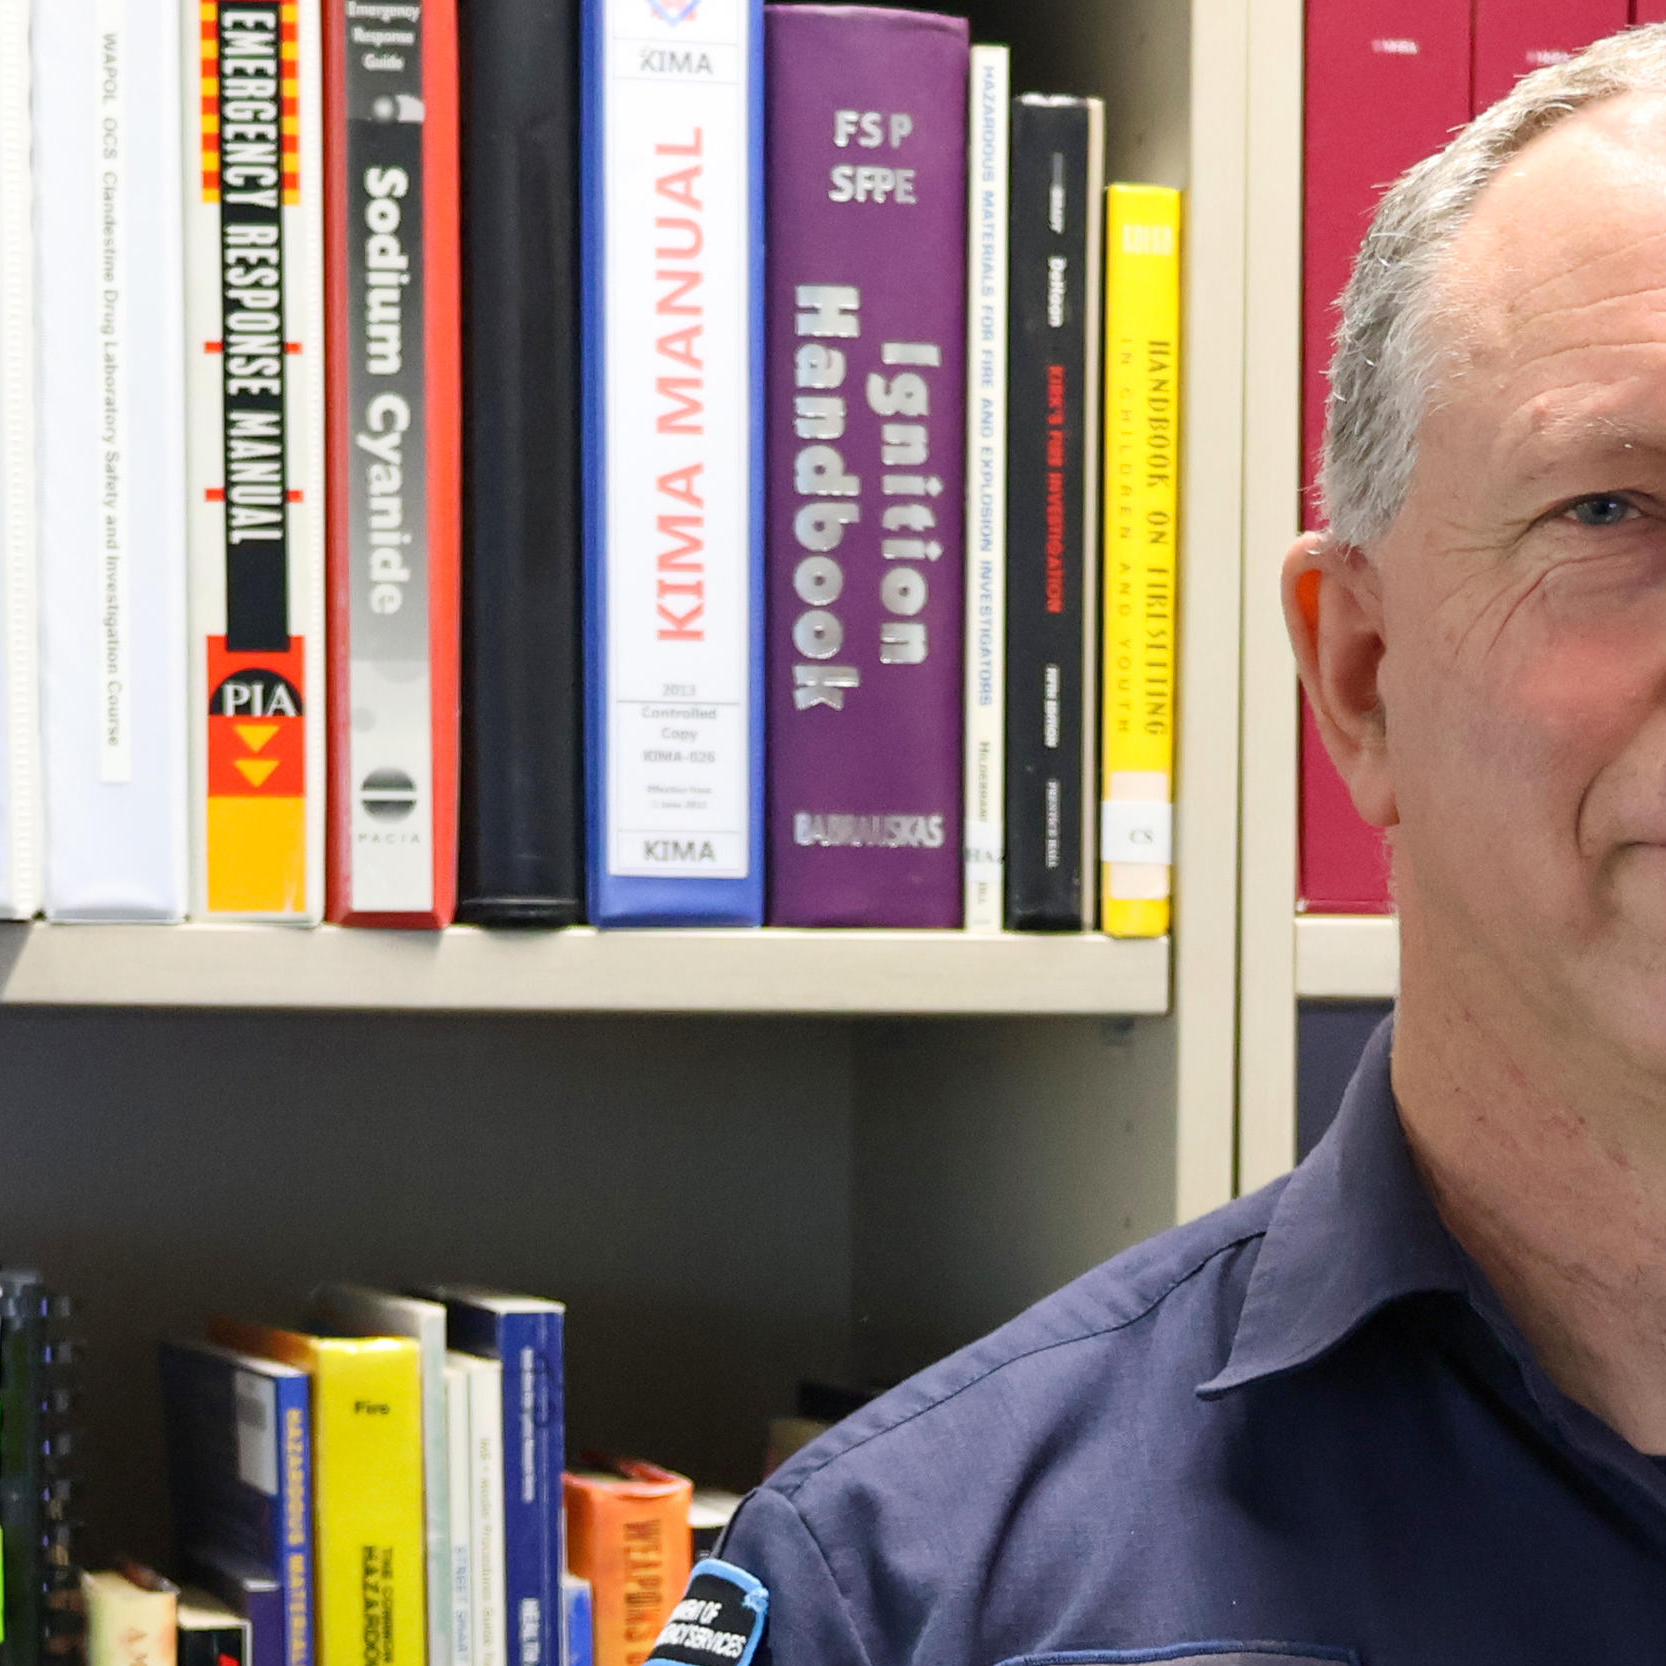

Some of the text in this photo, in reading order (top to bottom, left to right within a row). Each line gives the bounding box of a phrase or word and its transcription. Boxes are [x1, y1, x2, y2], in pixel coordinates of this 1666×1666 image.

[639, 53, 714, 75] KIMA
[829, 164, 917, 204] SFPE
[98, 33, 122, 746] WAPOL OCS Clandestine Drug Laboratory Safety and Investigation Course
[219, 11, 283, 545] EMERGENCY RESPONSE MANUAL
[359, 166, 411, 615] Sodium Cyanide
[654, 126, 705, 642] KIMA MANUAL
[977, 65, 996, 706] HAZARDOUS MATERIALS FOR FIRE AND EXPLOSION INVESTIGATORS
[222, 681, 299, 718] PIA
[791, 285, 861, 711] Handbook
[866, 342, 944, 665] Ignition
[1141, 341, 1172, 736] HANDBOOK ON FIRESETTING
[643, 840, 716, 861] KIMA
